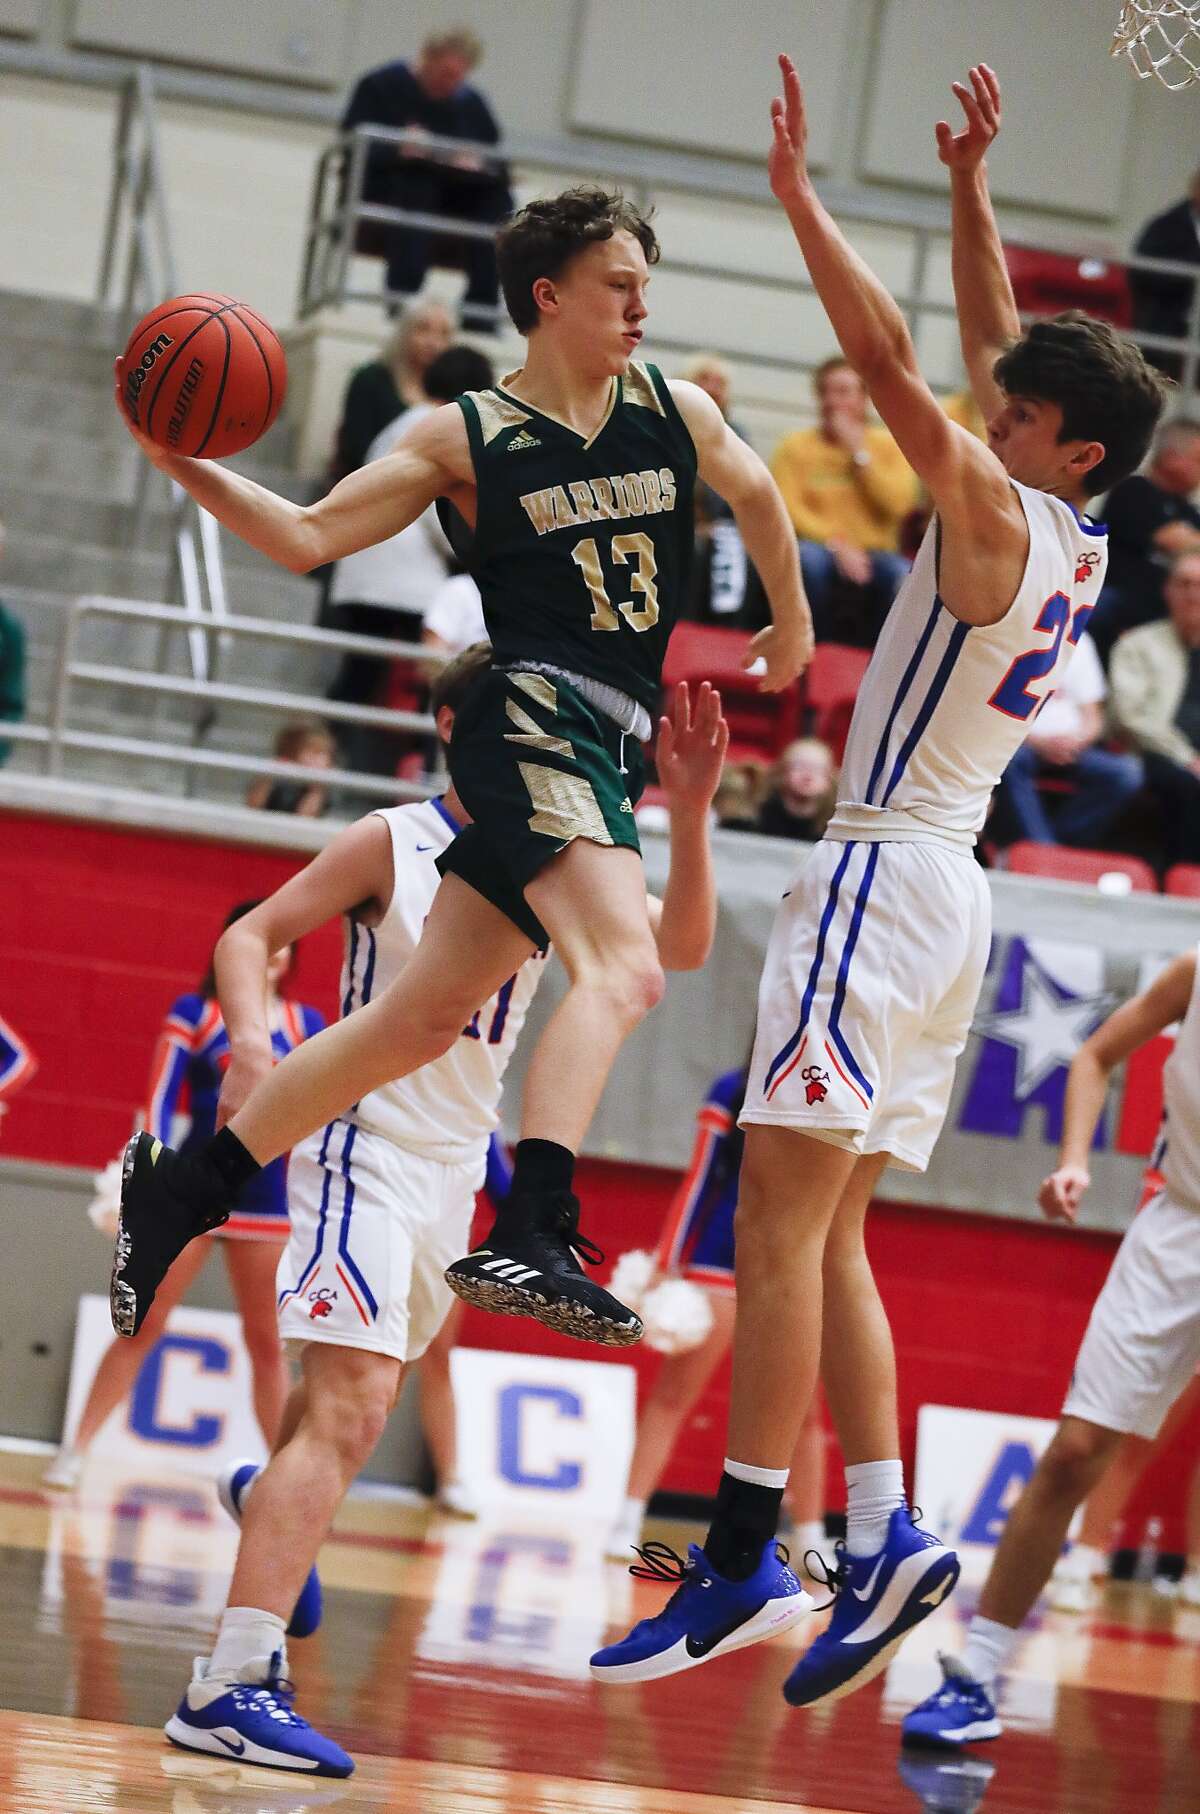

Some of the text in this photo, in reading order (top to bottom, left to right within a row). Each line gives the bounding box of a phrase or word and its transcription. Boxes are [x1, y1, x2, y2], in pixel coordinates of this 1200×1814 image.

[507, 439, 542, 452] adidas
[519, 467, 677, 536] WARRIORS
[571, 532, 659, 633] 13
[801, 1065, 831, 1083] CCA
[308, 1288, 338, 1302] CCA
[128, 1333, 230, 1447] C
[497, 1384, 583, 1489] C
